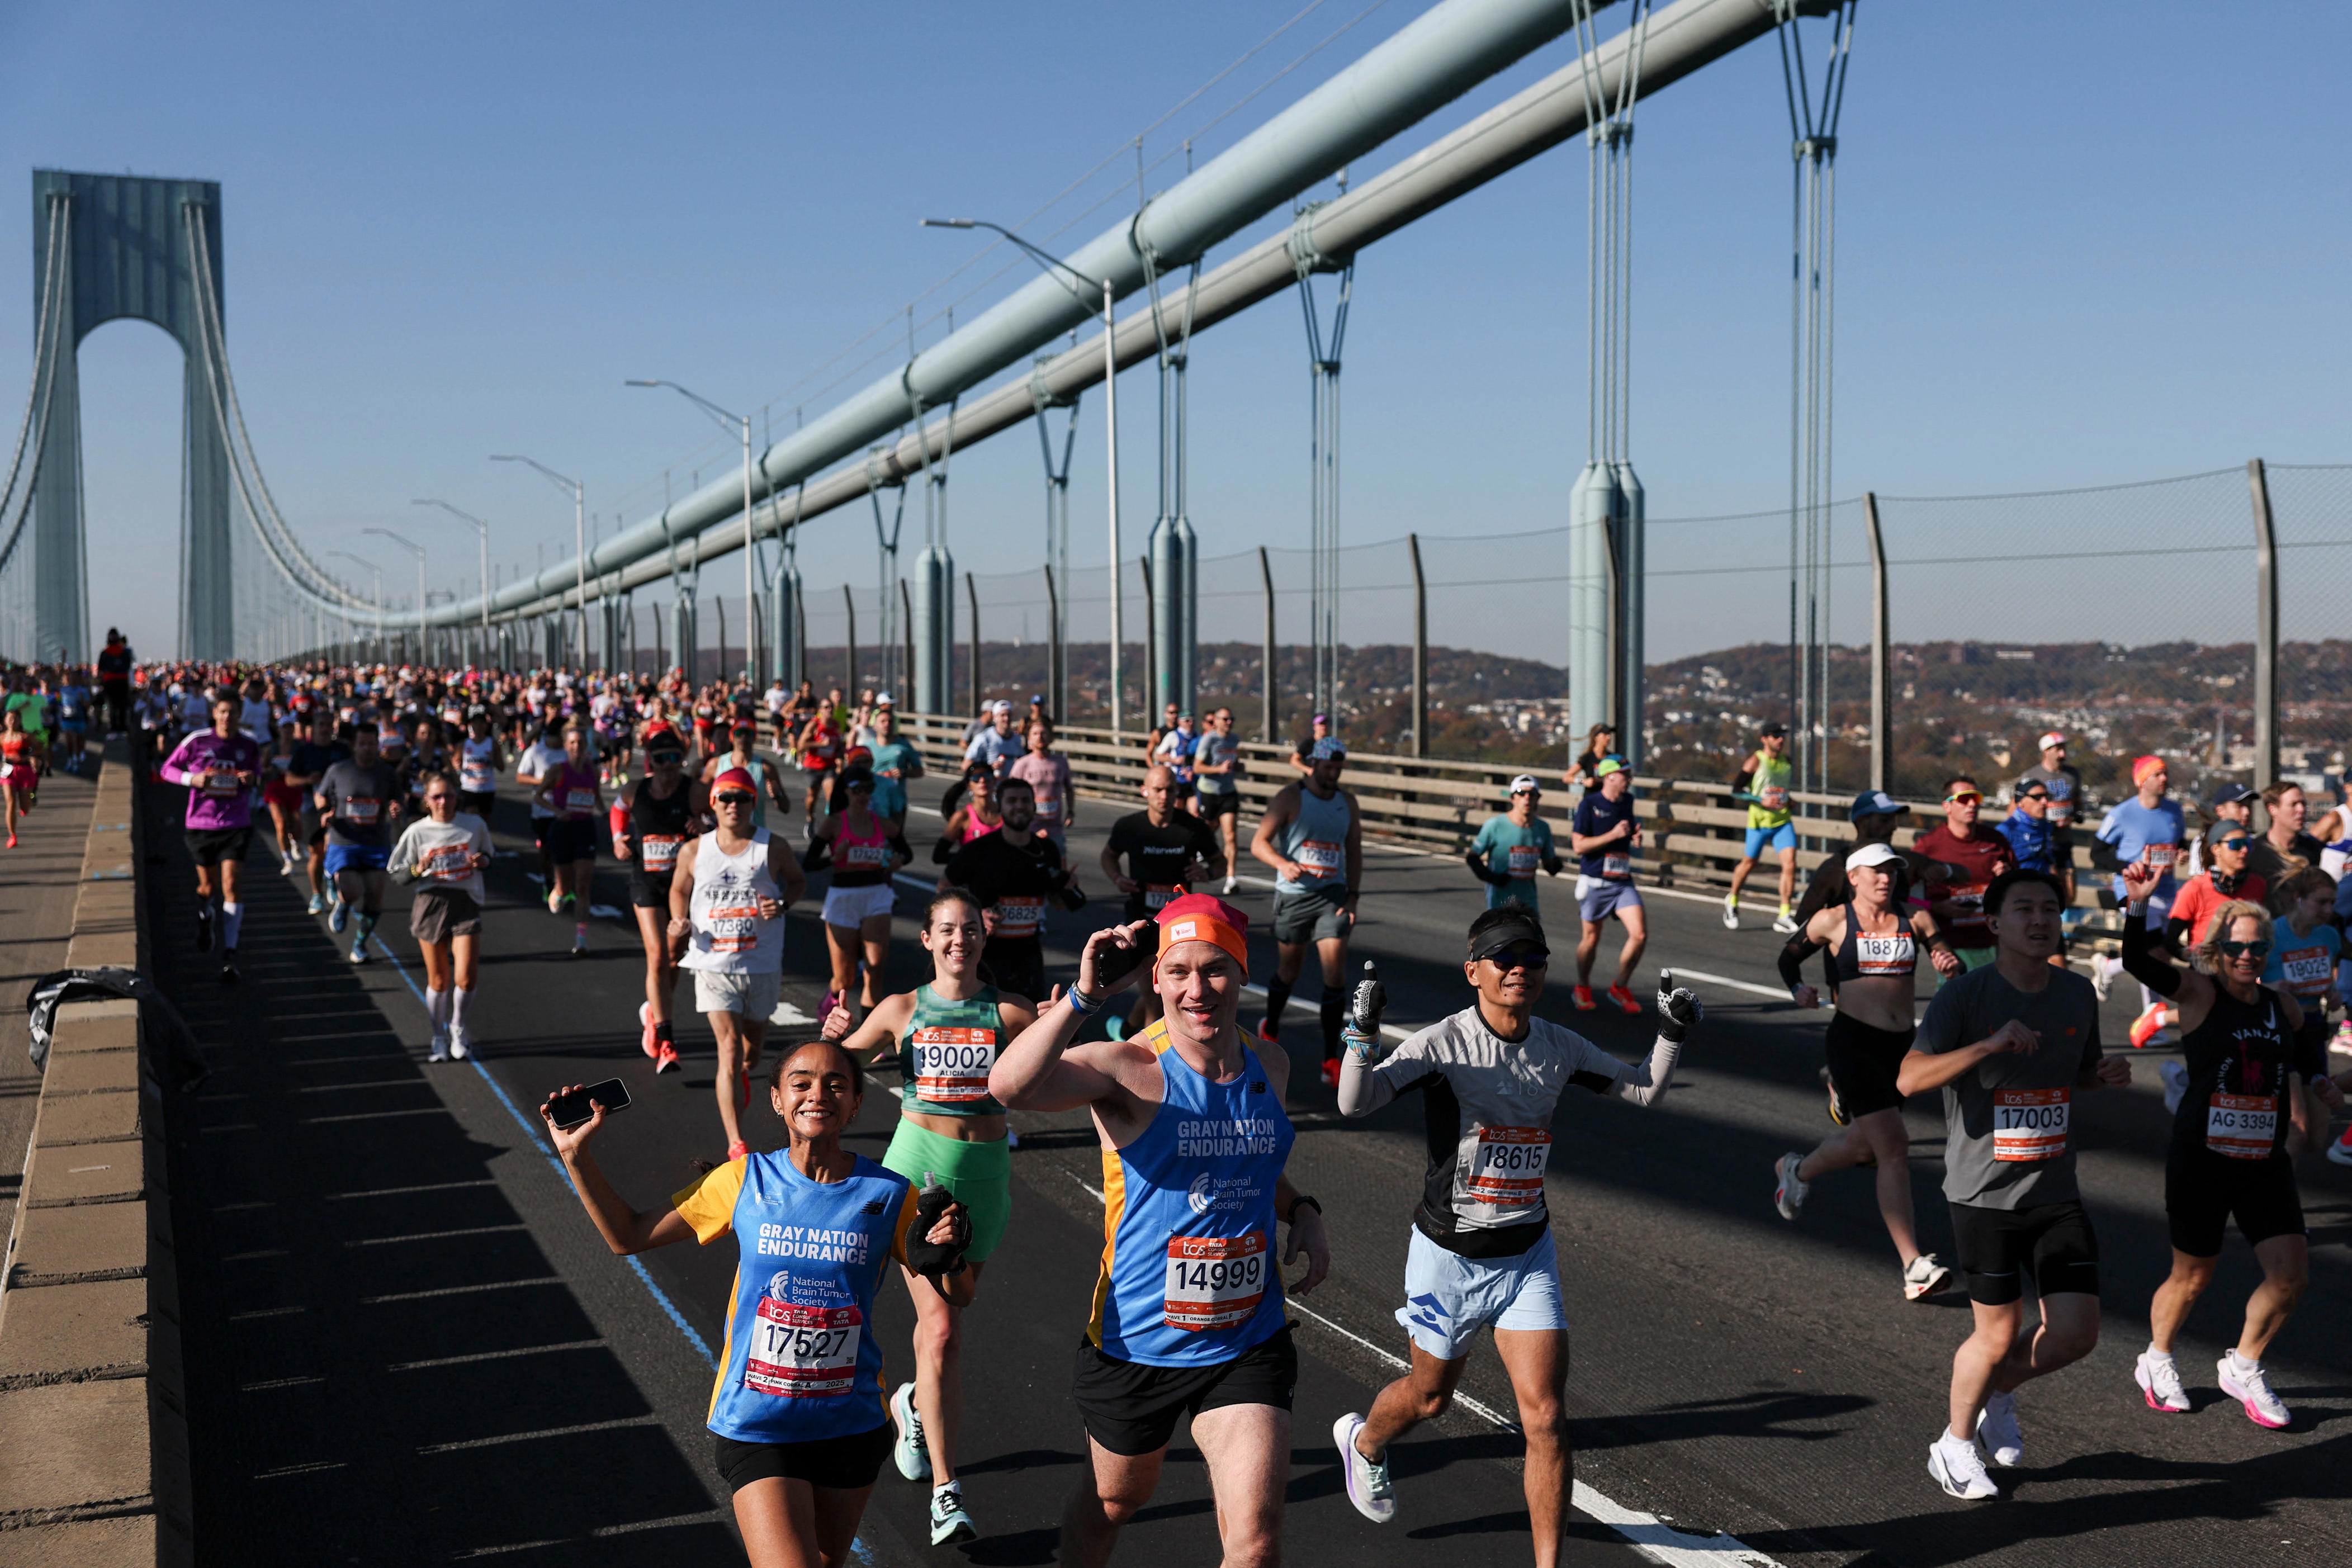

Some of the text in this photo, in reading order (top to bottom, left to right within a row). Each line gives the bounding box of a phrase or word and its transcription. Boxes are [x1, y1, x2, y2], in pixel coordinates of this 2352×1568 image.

[713, 919, 754, 934] 17360
[1864, 940, 1908, 957] 18877
[2289, 958, 2329, 978] 19025
[922, 1031, 940, 1041] tcs
[2232, 1029, 2281, 1045] VANJA
[919, 1046, 988, 1069] 19002
[2004, 1093, 2022, 1104] tcs
[2001, 1106, 2064, 1129] 17003
[2212, 1111, 2274, 1130] AG 3394
[1177, 1119, 1275, 1138] GRAY NATION
[1489, 1129, 1506, 1140] tcs
[1177, 1137, 1276, 1157] ENDURANCE
[1484, 1145, 1543, 1169] 18615
[1213, 1176, 1251, 1188] National
[1213, 1188, 1261, 1200] Brain Tumor
[1211, 1200, 1244, 1211] Society
[759, 1223, 868, 1248] GRAY NATION
[758, 1238, 867, 1265] ENDURANCE
[1183, 1241, 1206, 1256] tcs
[793, 1276, 835, 1287] National
[1176, 1257, 1260, 1291] 14999
[792, 1286, 850, 1299] Brain Tumor
[792, 1295, 827, 1308] Society
[769, 1304, 791, 1321] tcs
[792, 1314, 825, 1322] CONSULTANCY
[766, 1324, 849, 1358] 17527
[825, 1380, 845, 1388] 2025
